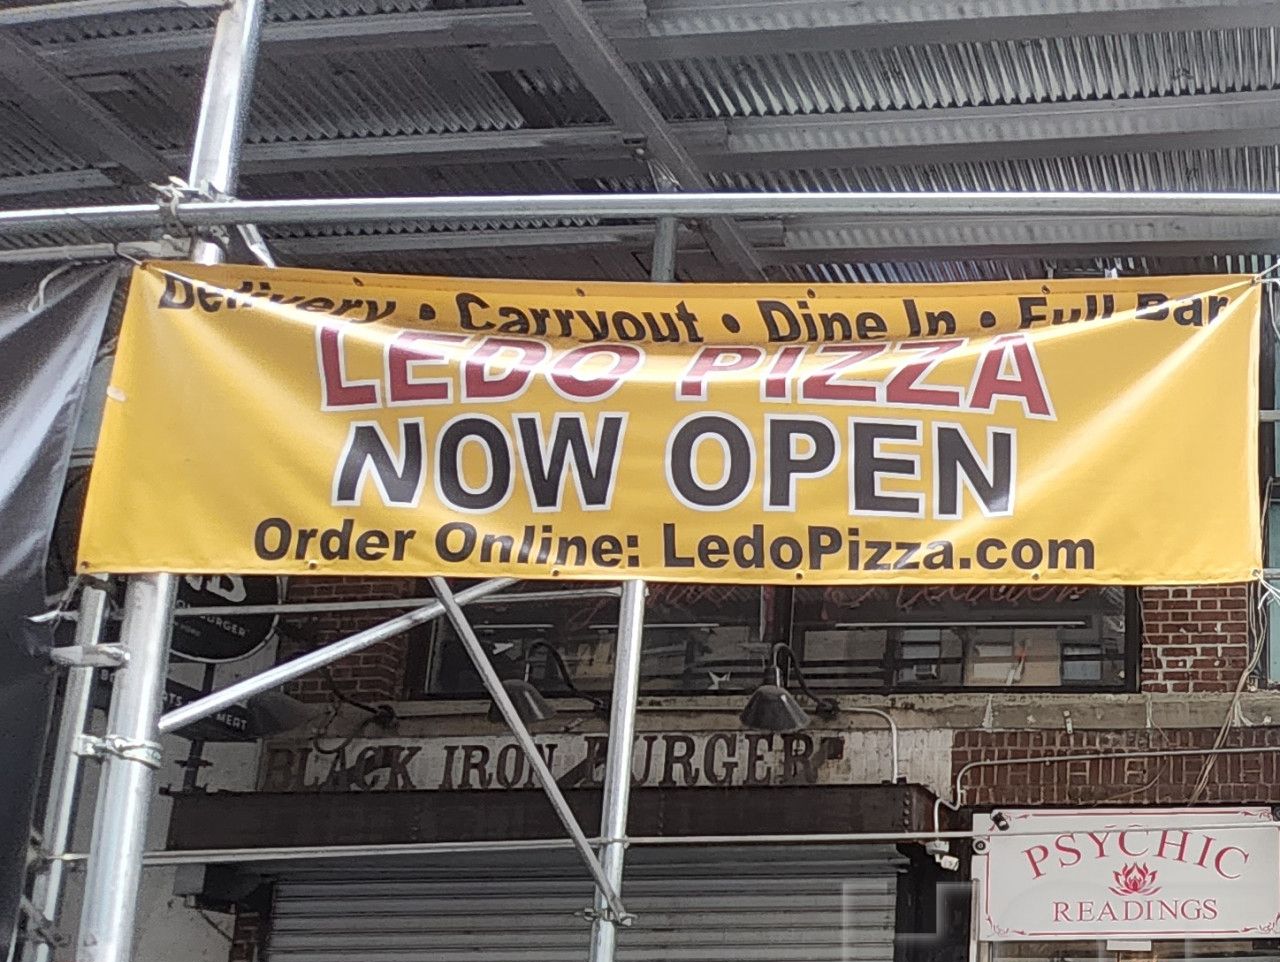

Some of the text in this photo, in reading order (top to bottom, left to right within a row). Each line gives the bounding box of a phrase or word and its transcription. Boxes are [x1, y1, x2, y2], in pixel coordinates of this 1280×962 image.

[157, 273, 1231, 344] Delivery Carryout Dine In Full Bar
[315, 323, 1058, 421] LEDO PIZZA
[331, 411, 1018, 520] NOW OPEN
[254, 517, 1095, 571] Order Online: LedoPizza.com
[263, 742, 421, 792] BLACK
[441, 742, 558, 789] IRON
[1021, 823, 1249, 880] PSYCHIC
[1052, 898, 1218, 922] READINGS
